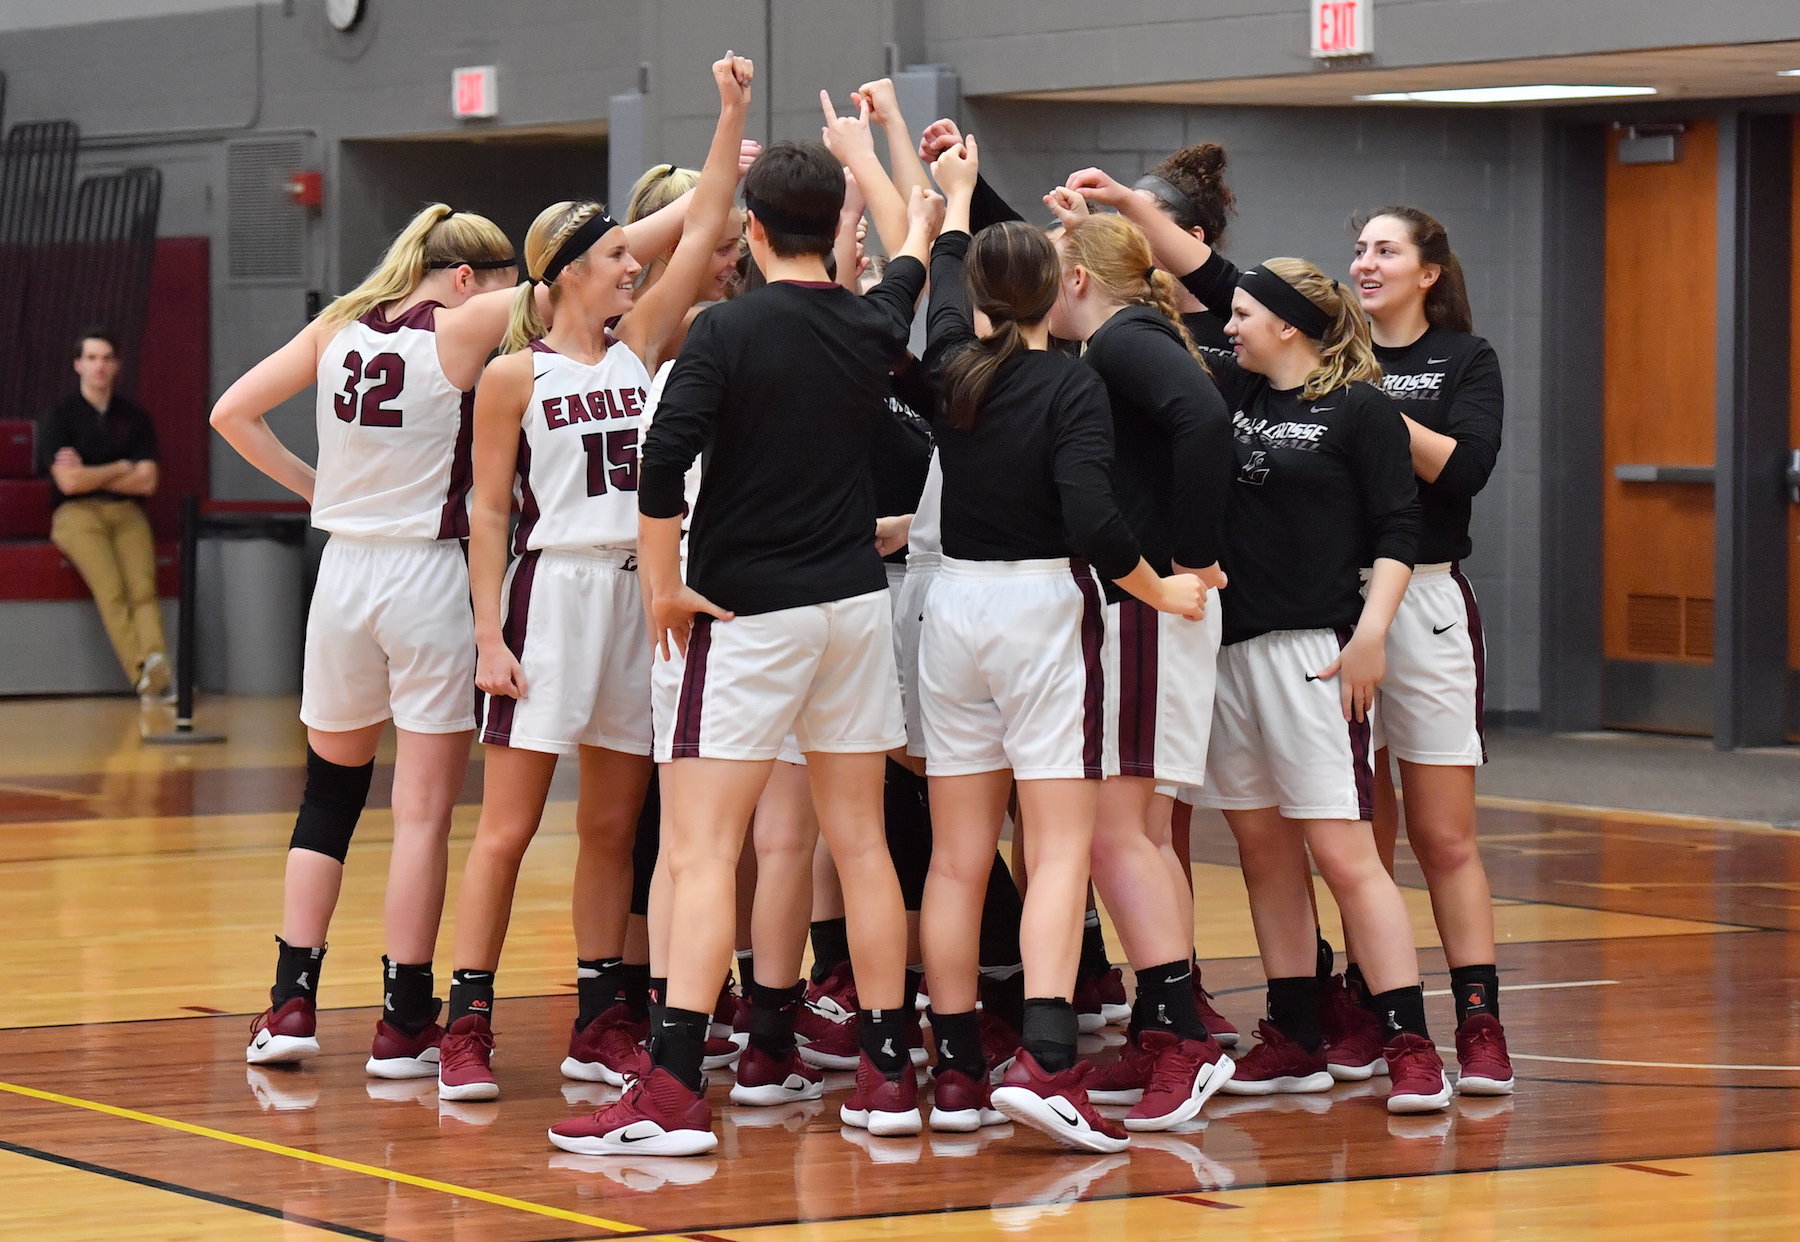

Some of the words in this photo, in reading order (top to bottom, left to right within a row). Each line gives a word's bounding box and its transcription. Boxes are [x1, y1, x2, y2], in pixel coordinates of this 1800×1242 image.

[1319, 2, 1356, 50] EXIT
[333, 349, 406, 428] 32
[1382, 372, 1446, 391] ROSSE
[581, 428, 638, 497] 15
